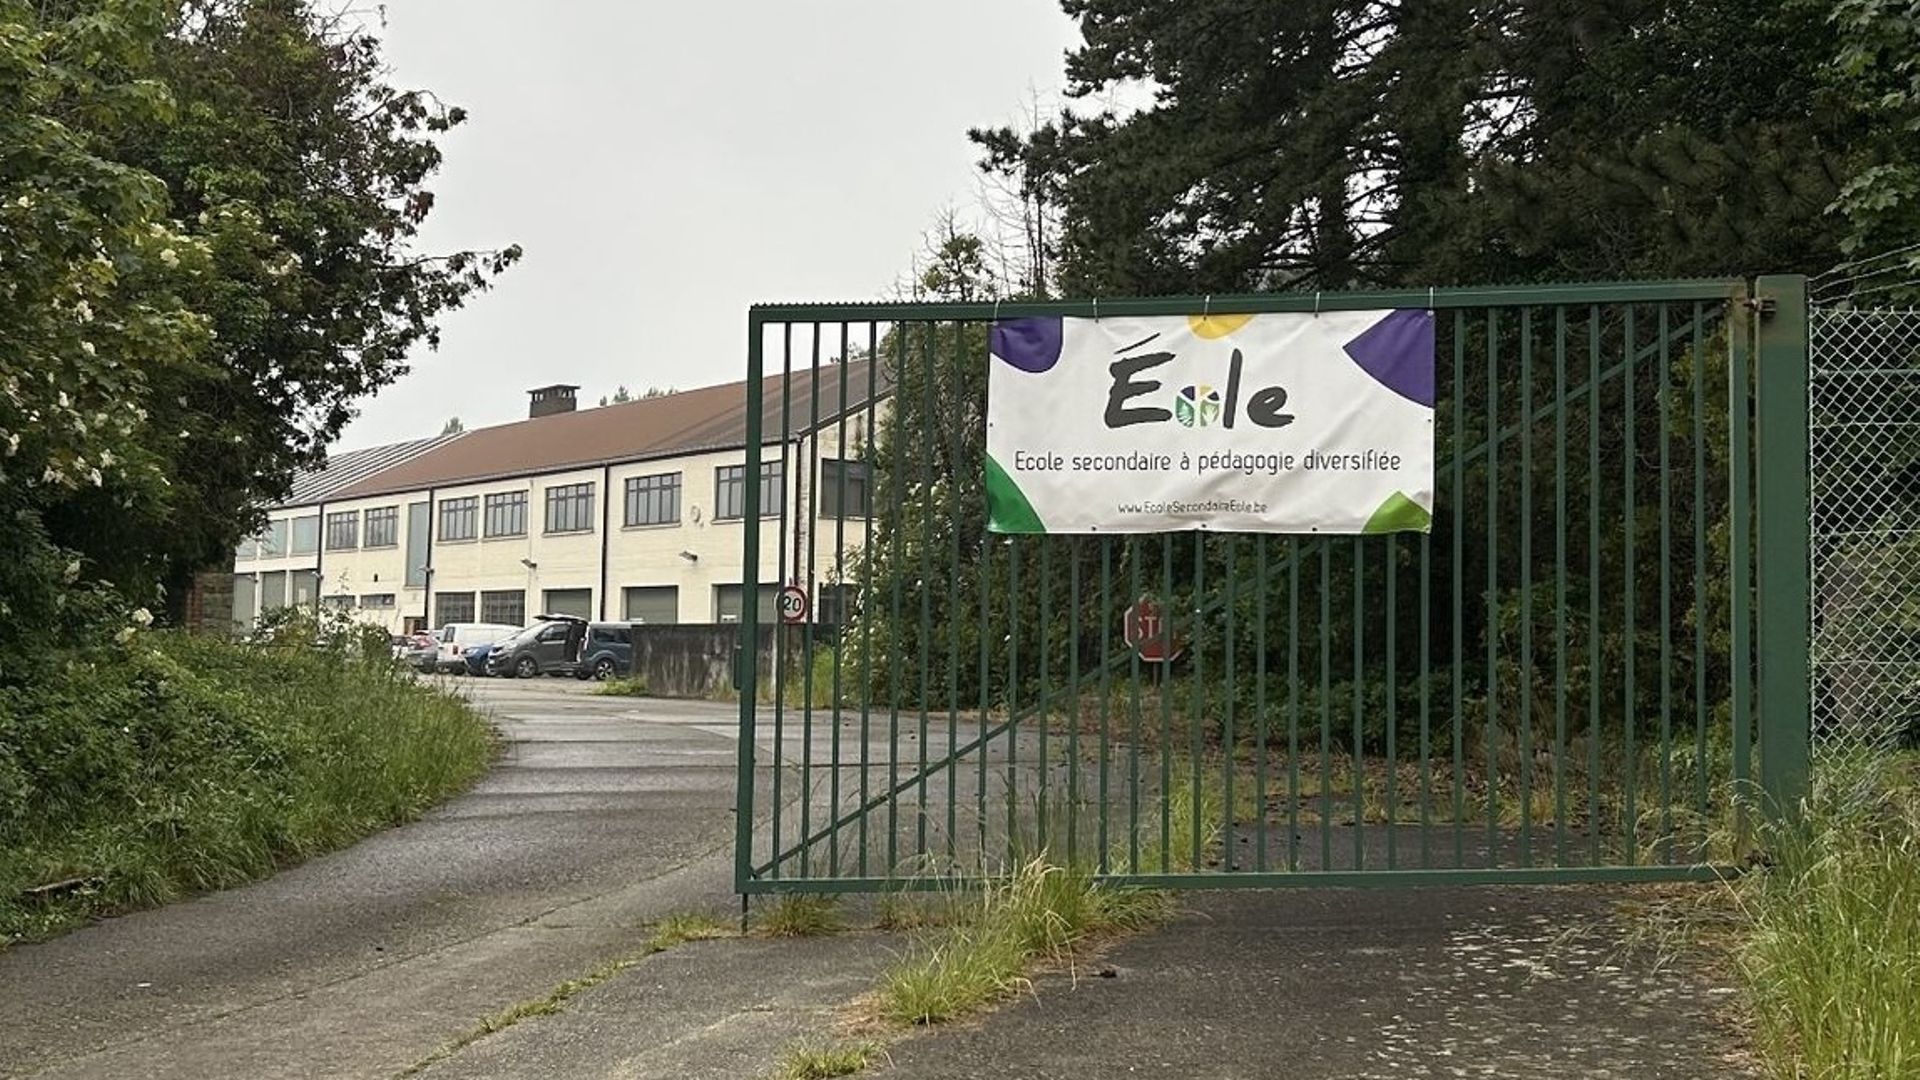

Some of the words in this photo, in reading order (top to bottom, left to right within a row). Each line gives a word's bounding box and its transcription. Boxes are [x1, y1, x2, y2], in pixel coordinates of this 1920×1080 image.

[1014, 450, 1064, 471] Ecole
[1072, 451, 1171, 471] secondaire
[1179, 452, 1190, 470] à
[1198, 449, 1294, 475] pédagogie
[1303, 449, 1401, 470] diversifiée
[783, 596, 801, 612] 20
